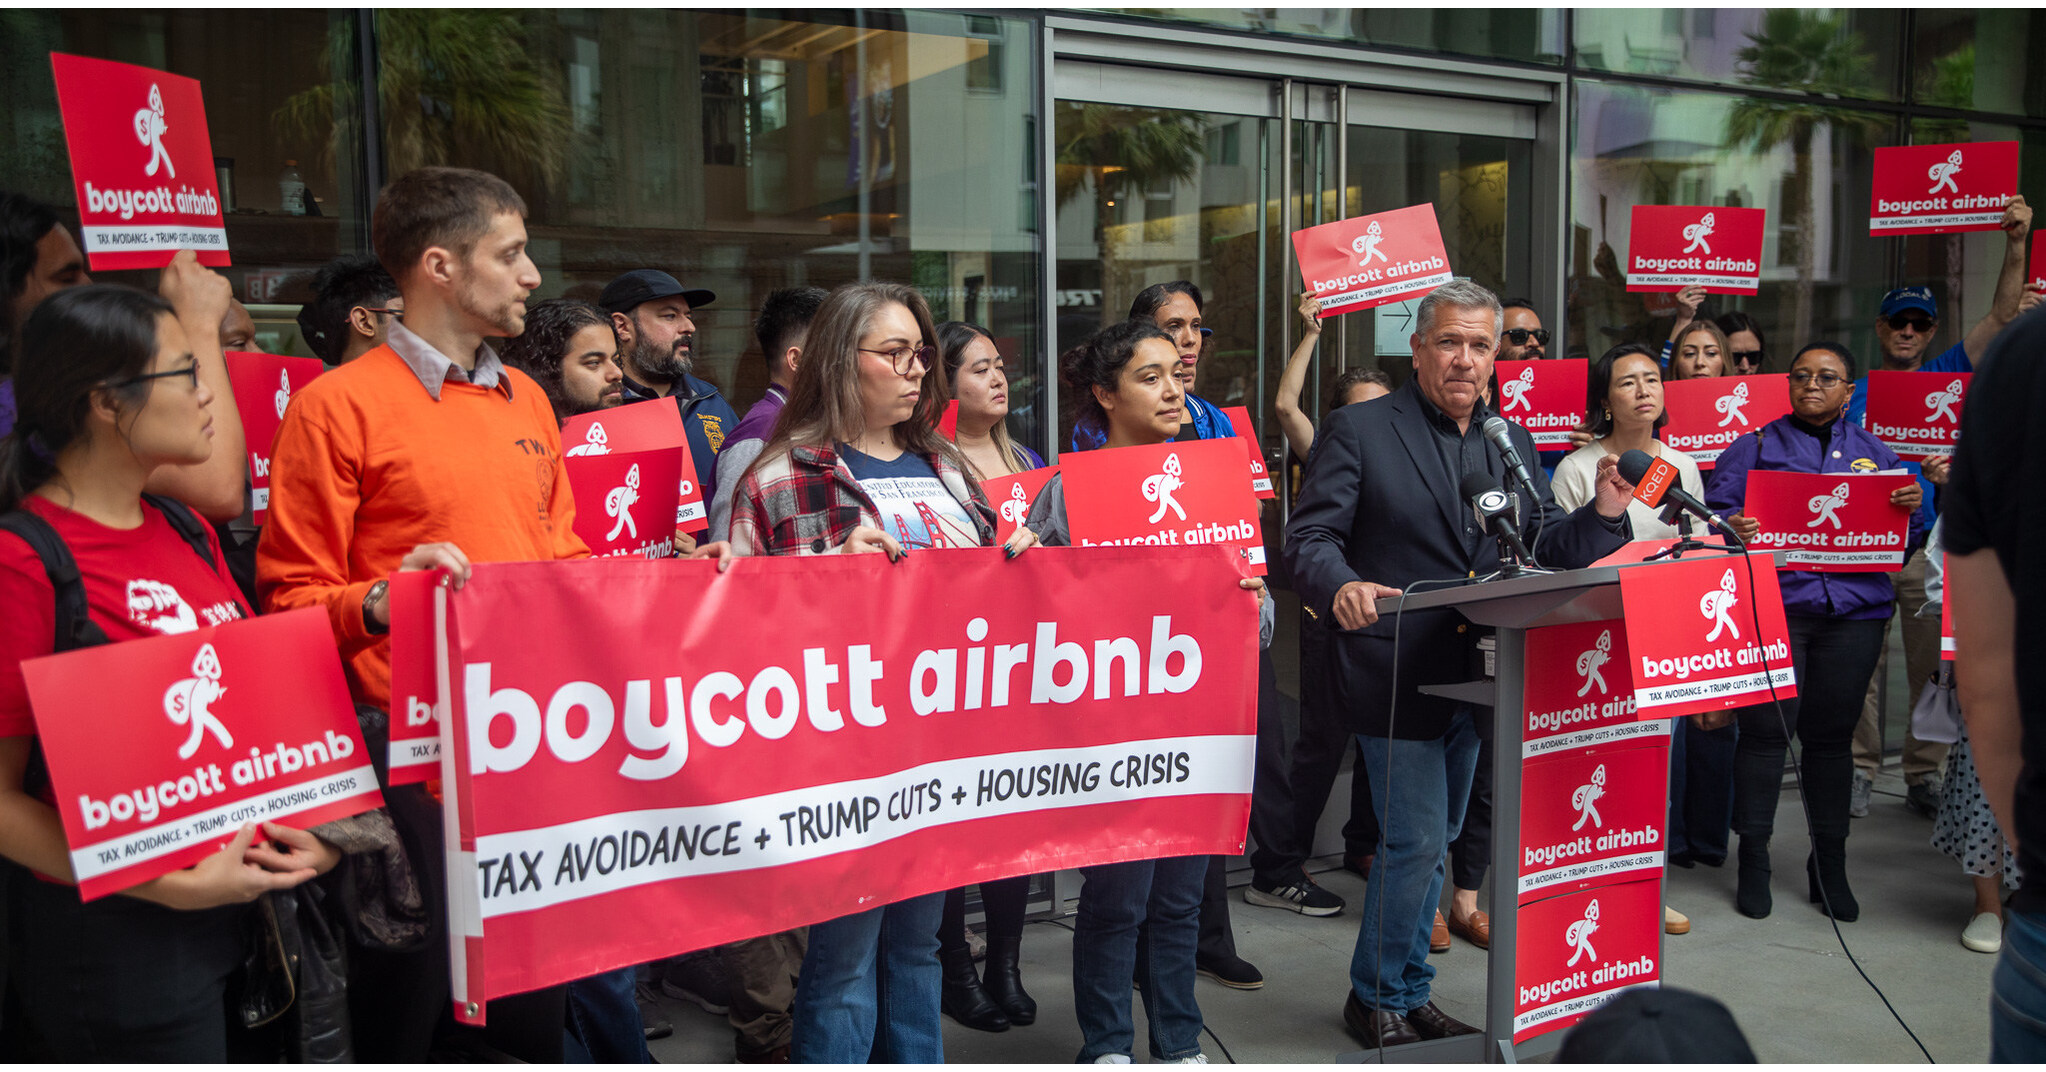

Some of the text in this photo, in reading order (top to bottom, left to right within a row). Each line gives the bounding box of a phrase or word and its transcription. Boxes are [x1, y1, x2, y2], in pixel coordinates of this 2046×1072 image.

[84, 181, 218, 220] boycott airbnb
[1878, 198, 1948, 214] boycott
[97, 233, 110, 245] TAX
[112, 232, 148, 244] AVOIDANCE
[156, 232, 178, 244] TRUMP
[178, 233, 189, 244] CUTS
[192, 233, 208, 244] HOUSING
[208, 234, 220, 244] CRISIS
[1312, 256, 1444, 293] boycott airbnb
[1635, 256, 1756, 272] boycott airbnb
[1320, 299, 1329, 307] TAX
[1330, 294, 1359, 304] AVOIDANCE
[1365, 289, 1384, 299] TRUMP
[1404, 280, 1427, 290] HOUSING
[1428, 276, 1445, 285] CRISIS
[1526, 412, 1581, 427] airbnb
[1872, 422, 1945, 440] boycott
[1668, 430, 1739, 448] boycott
[879, 490, 898, 499] SAN
[899, 489, 945, 498] FRANCISCO
[893, 480, 940, 489] EDUCATORS
[1640, 464, 1668, 501] KQED
[676, 507, 694, 519] RISIS
[1184, 519, 1255, 545] airbnb
[1750, 531, 1900, 547] boycott airbnb
[1642, 638, 1788, 679] boycott airbnb
[464, 615, 1202, 781] boycott airbnb
[1649, 691, 1662, 701] TAX
[1664, 686, 1702, 700] AVOIDANCE
[1709, 682, 1732, 693] TRUMP
[1733, 680, 1748, 690] CUTS
[1775, 672, 1789, 682] CRISIS
[1529, 695, 1637, 732] boycott airb
[1540, 739, 1568, 750] AVOIDANCE
[1574, 734, 1594, 744] TRUMP
[1595, 730, 1609, 740] CUTS
[1615, 726, 1639, 737] HOUSING
[1640, 724, 1659, 732] CRISIS
[411, 744, 430, 758] TAX
[78, 730, 354, 831] boycott airbnb
[97, 848, 120, 865] TAX
[125, 828, 182, 856] AVOIDANCE
[184, 829, 190, 837] +
[192, 814, 228, 835] TRUMP
[231, 806, 256, 823] CUTS
[267, 789, 317, 812] HOUSING
[320, 777, 357, 796] CRISIS
[478, 752, 1190, 898] TAX AVOIDANCE + TRUMP CUTS + HOUSING CRISIS
[1525, 825, 1659, 866] boycott airbnb
[1525, 879, 1534, 887] TAX
[1535, 872, 1562, 884] AVOIDANCE
[1568, 866, 1588, 877] TRUMP
[1589, 864, 1603, 873] CUTS
[1609, 859, 1634, 870] HOUSING
[1635, 856, 1653, 866] CRISIS
[1520, 956, 1654, 1006] boycott airbnb
[1530, 1009, 1558, 1023] AVOIDANCE
[1564, 1001, 1584, 1012] TRUMP
[1585, 998, 1600, 1007] CUTS
